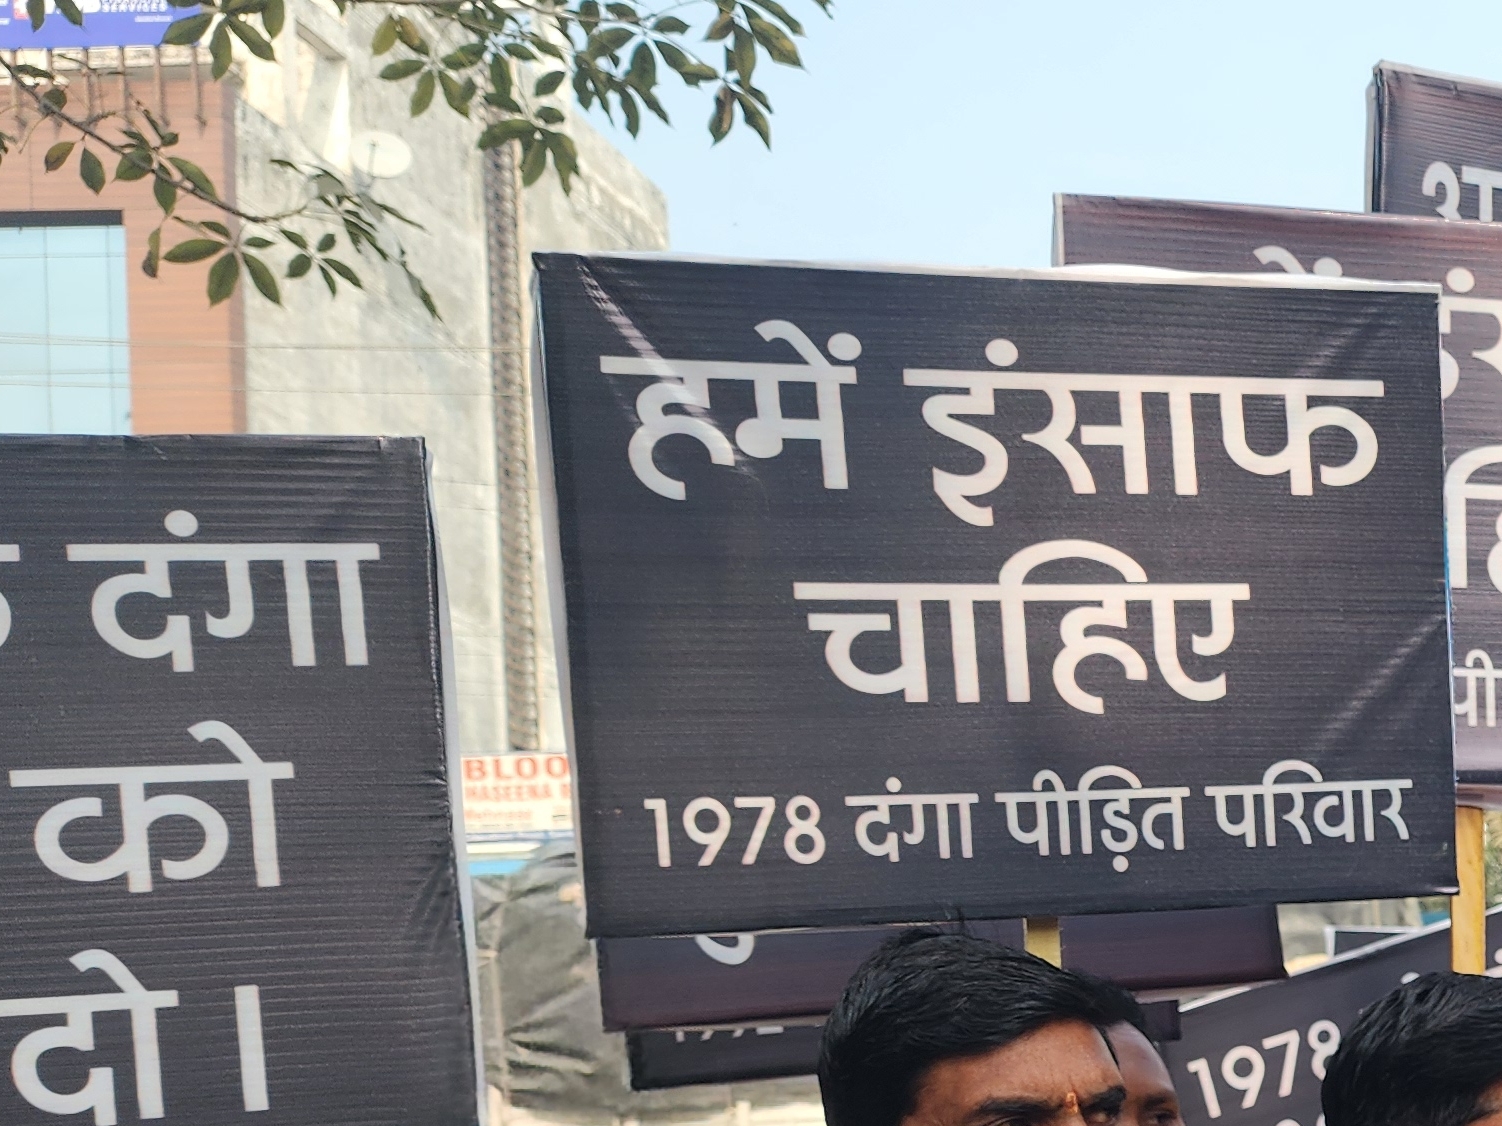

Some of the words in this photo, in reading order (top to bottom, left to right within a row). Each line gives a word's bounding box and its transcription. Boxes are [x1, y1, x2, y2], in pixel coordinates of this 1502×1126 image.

[600, 319, 863, 501] हमें
[903, 338, 1385, 527] इंसाफ
[66, 509, 381, 673] दंगा
[793, 539, 1251, 715] चाहिए
[9, 720, 295, 893] को
[643, 796, 826, 867] 1978
[845, 776, 979, 862] दंगा
[995, 765, 1190, 872] पीड़ित
[1205, 759, 1413, 849] परिवार
[1186, 1019, 1342, 1119] 1978
